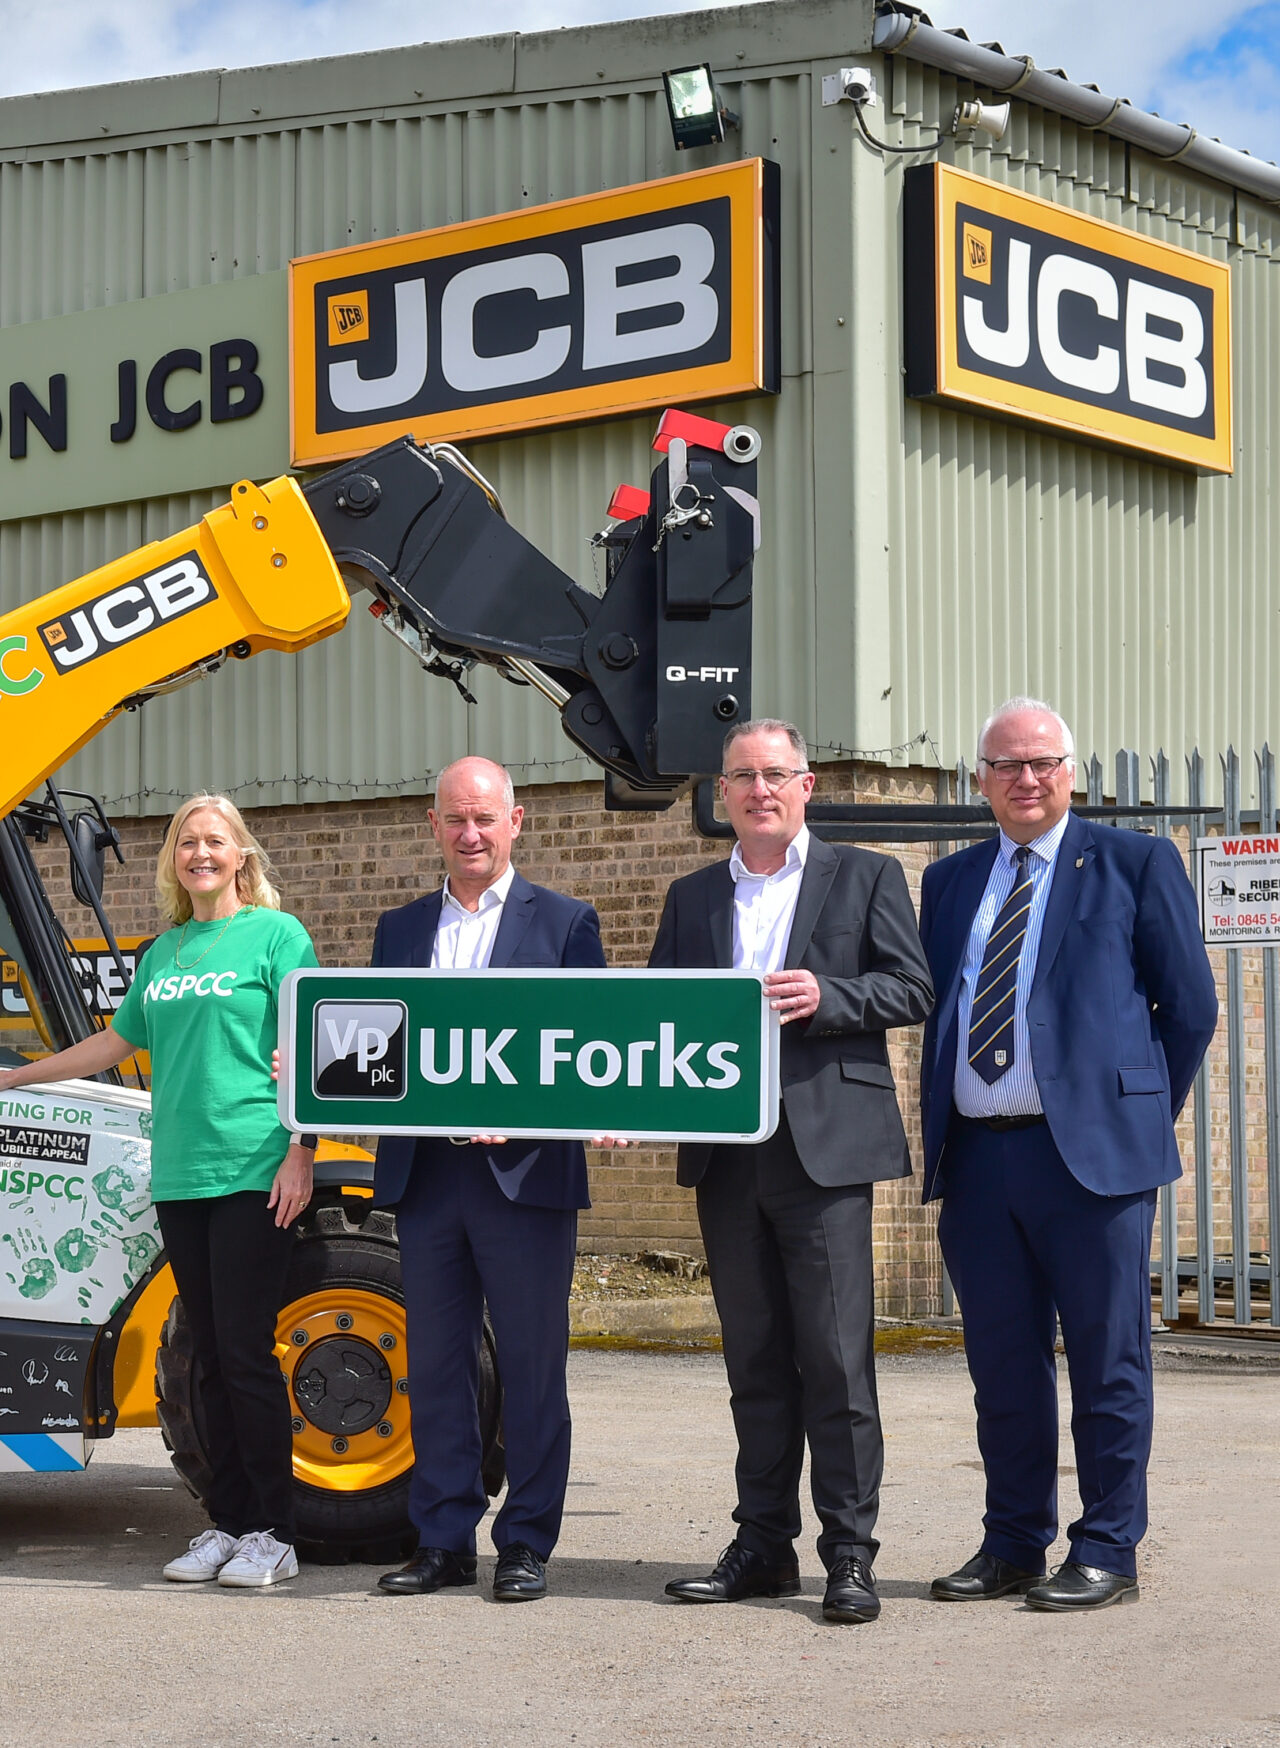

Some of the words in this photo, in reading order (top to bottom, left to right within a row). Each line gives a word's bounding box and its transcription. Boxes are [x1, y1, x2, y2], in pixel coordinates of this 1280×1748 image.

[328, 222, 720, 413] JCB
[339, 308, 362, 330] JCB
[961, 236, 1208, 419] JCB
[110, 338, 264, 444] JCB
[53, 559, 211, 667] JCB
[666, 666, 739, 683] Q-FIT
[1222, 838, 1279, 855] WARN
[1209, 860, 1231, 868] These
[1234, 858, 1267, 868] premises
[1250, 879, 1280, 890] RIBE
[1238, 891, 1279, 903] SECUR
[1212, 914, 1234, 927] Tel:
[1237, 914, 1267, 926] 0845
[1209, 926, 1262, 937] MONITORING
[1264, 926, 1271, 934] &
[144, 971, 237, 1004] NSPCC
[324, 1019, 389, 1073] Vp
[420, 1028, 519, 1085] UK
[540, 1022, 741, 1089] Forks
[372, 1064, 395, 1086] plc
[52, 1106, 93, 1126] FOR
[0, 1159, 11, 1168] aid
[13, 1160, 22, 1168] of
[41, 1148, 84, 1162] APPEAL
